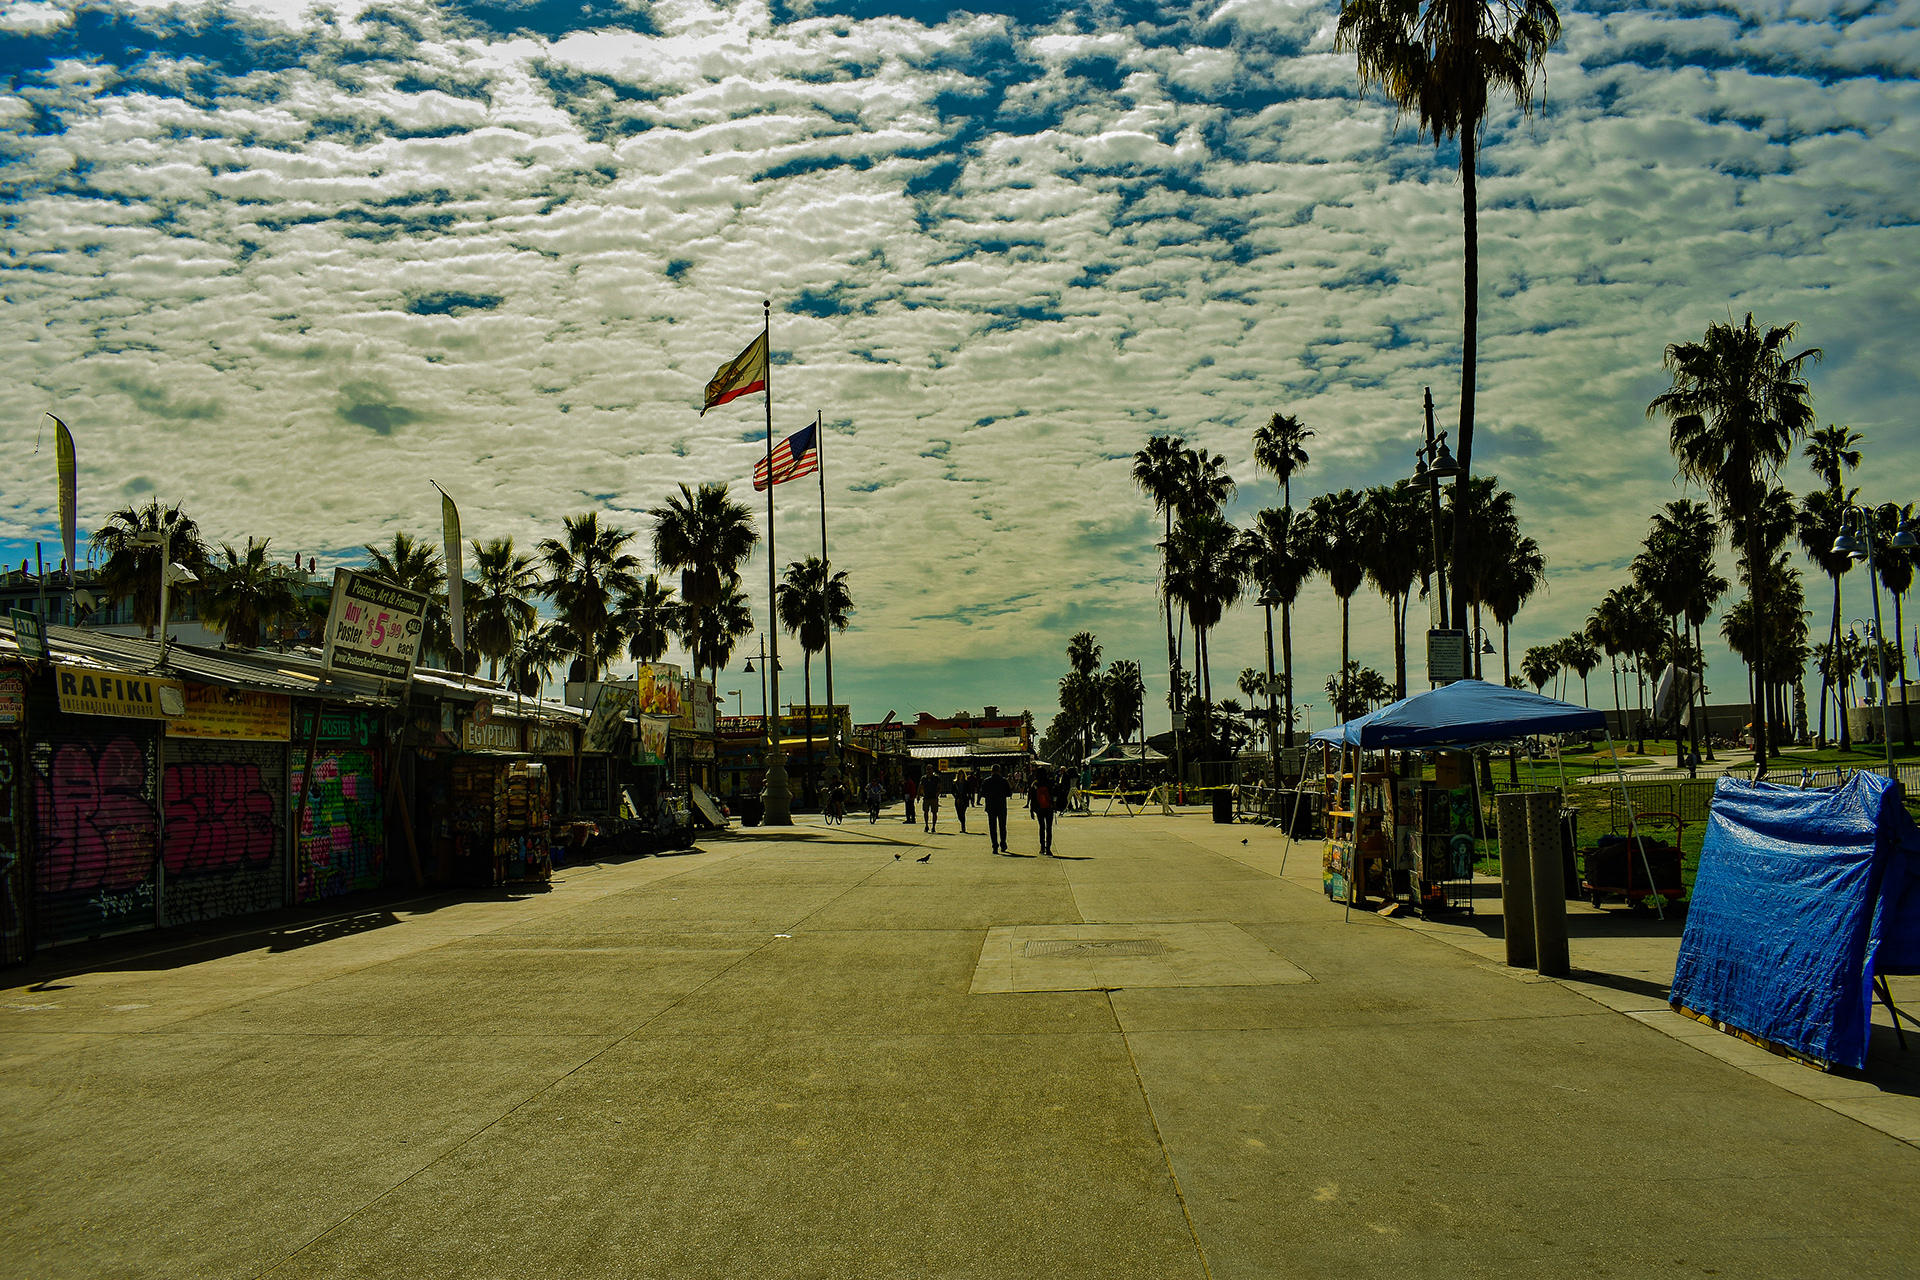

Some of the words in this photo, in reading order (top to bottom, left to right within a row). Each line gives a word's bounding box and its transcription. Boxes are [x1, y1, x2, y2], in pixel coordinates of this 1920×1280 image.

[352, 578, 377, 601] Posters,
[377, 588, 388, 602] Art
[388, 592, 395, 604] &
[394, 594, 420, 615] Framing
[345, 602, 362, 624] Any
[15, 617, 39, 636] ATM
[336, 621, 363, 644] Poster
[408, 620, 420, 632] SALE
[397, 642, 414, 656] each
[61, 672, 153, 703] RAFIKI
[63, 698, 120, 714] INTERNATIONAL
[123, 704, 154, 716] IMPORTS
[303, 720, 313, 735] AN
[322, 719, 351, 735] POSTER
[738, 717, 763, 729] Bay
[468, 722, 517, 748] EGYPTIAN
